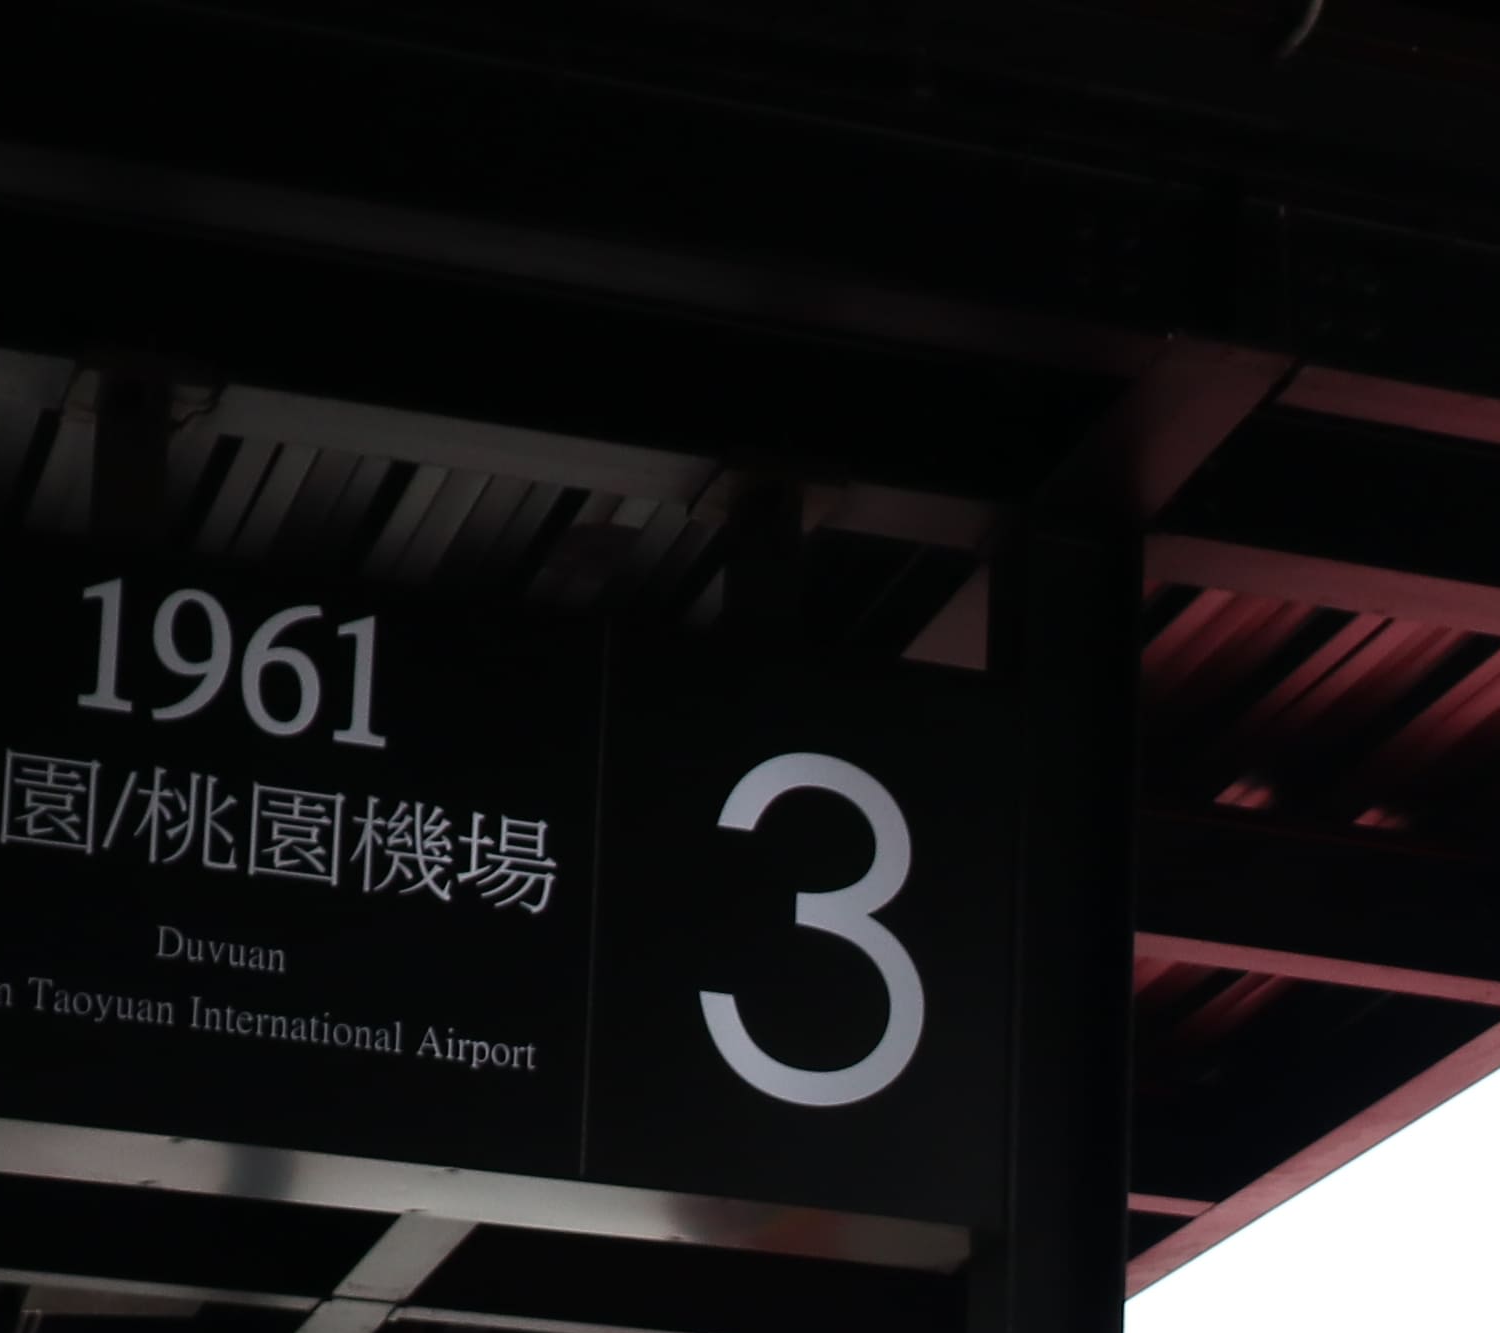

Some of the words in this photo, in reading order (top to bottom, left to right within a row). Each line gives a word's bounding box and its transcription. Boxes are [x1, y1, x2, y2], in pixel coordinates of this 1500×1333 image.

[77, 578, 387, 747] 1961
[156, 925, 287, 972] Duvuan
[700, 752, 925, 1107] 3
[28, 977, 174, 1025] Taoyuan
[190, 997, 402, 1053] International
[417, 1027, 536, 1070] Airport
